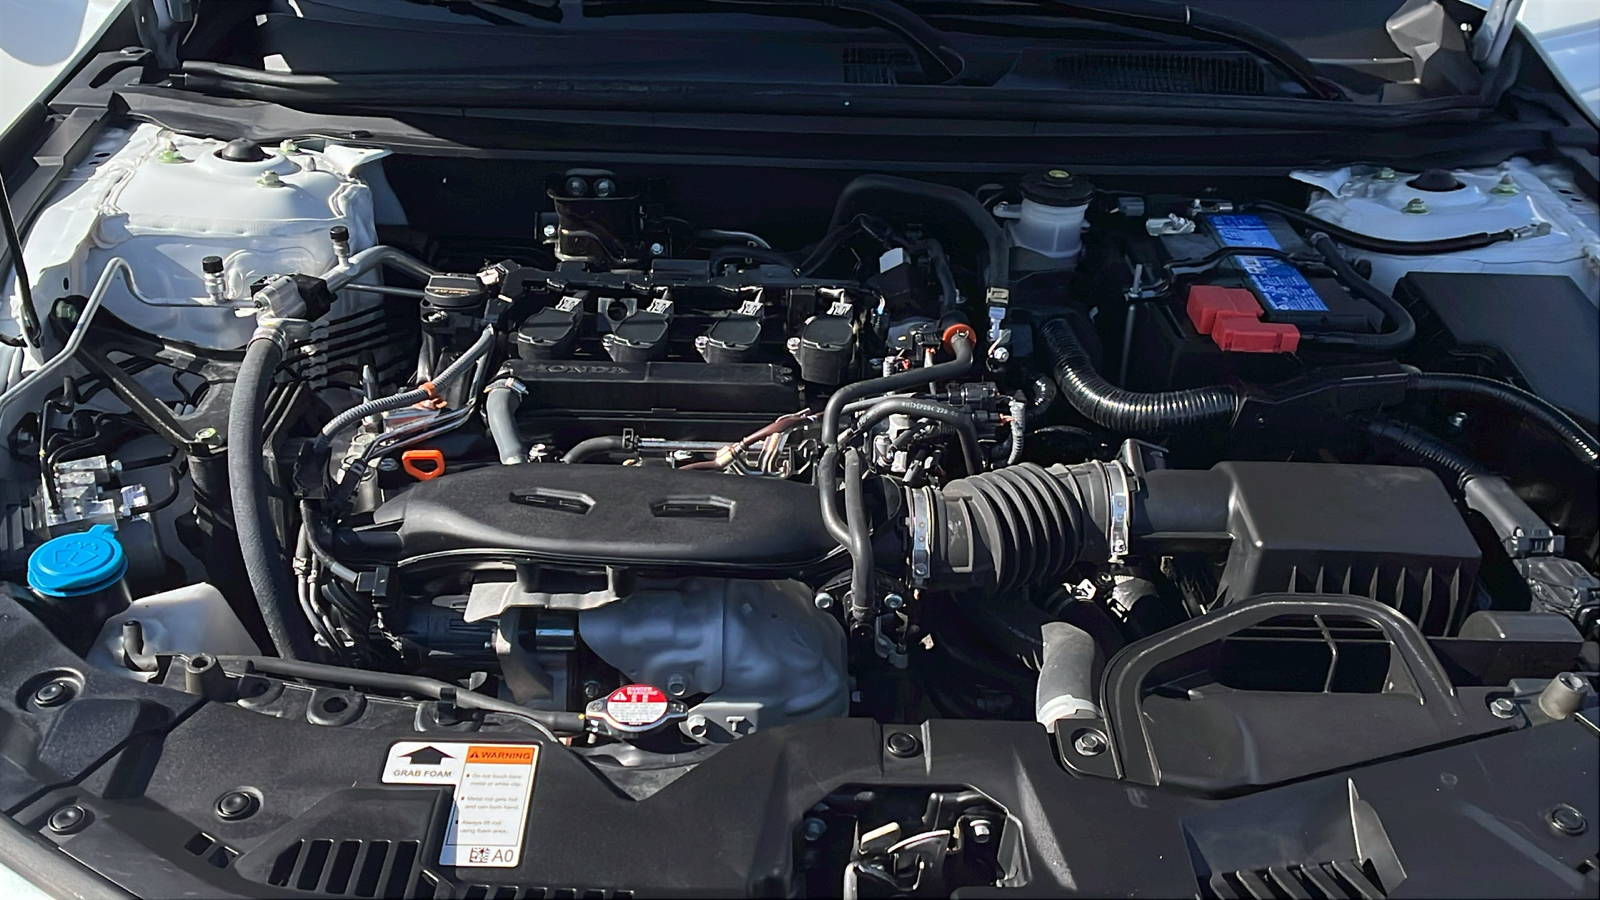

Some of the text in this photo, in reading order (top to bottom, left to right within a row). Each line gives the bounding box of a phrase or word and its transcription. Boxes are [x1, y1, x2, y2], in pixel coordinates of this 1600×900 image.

[525, 363, 631, 374] HONDA
[481, 751, 531, 760] WARNING
[393, 769, 452, 778] GRAB FOAM
[491, 849, 514, 863] A0
